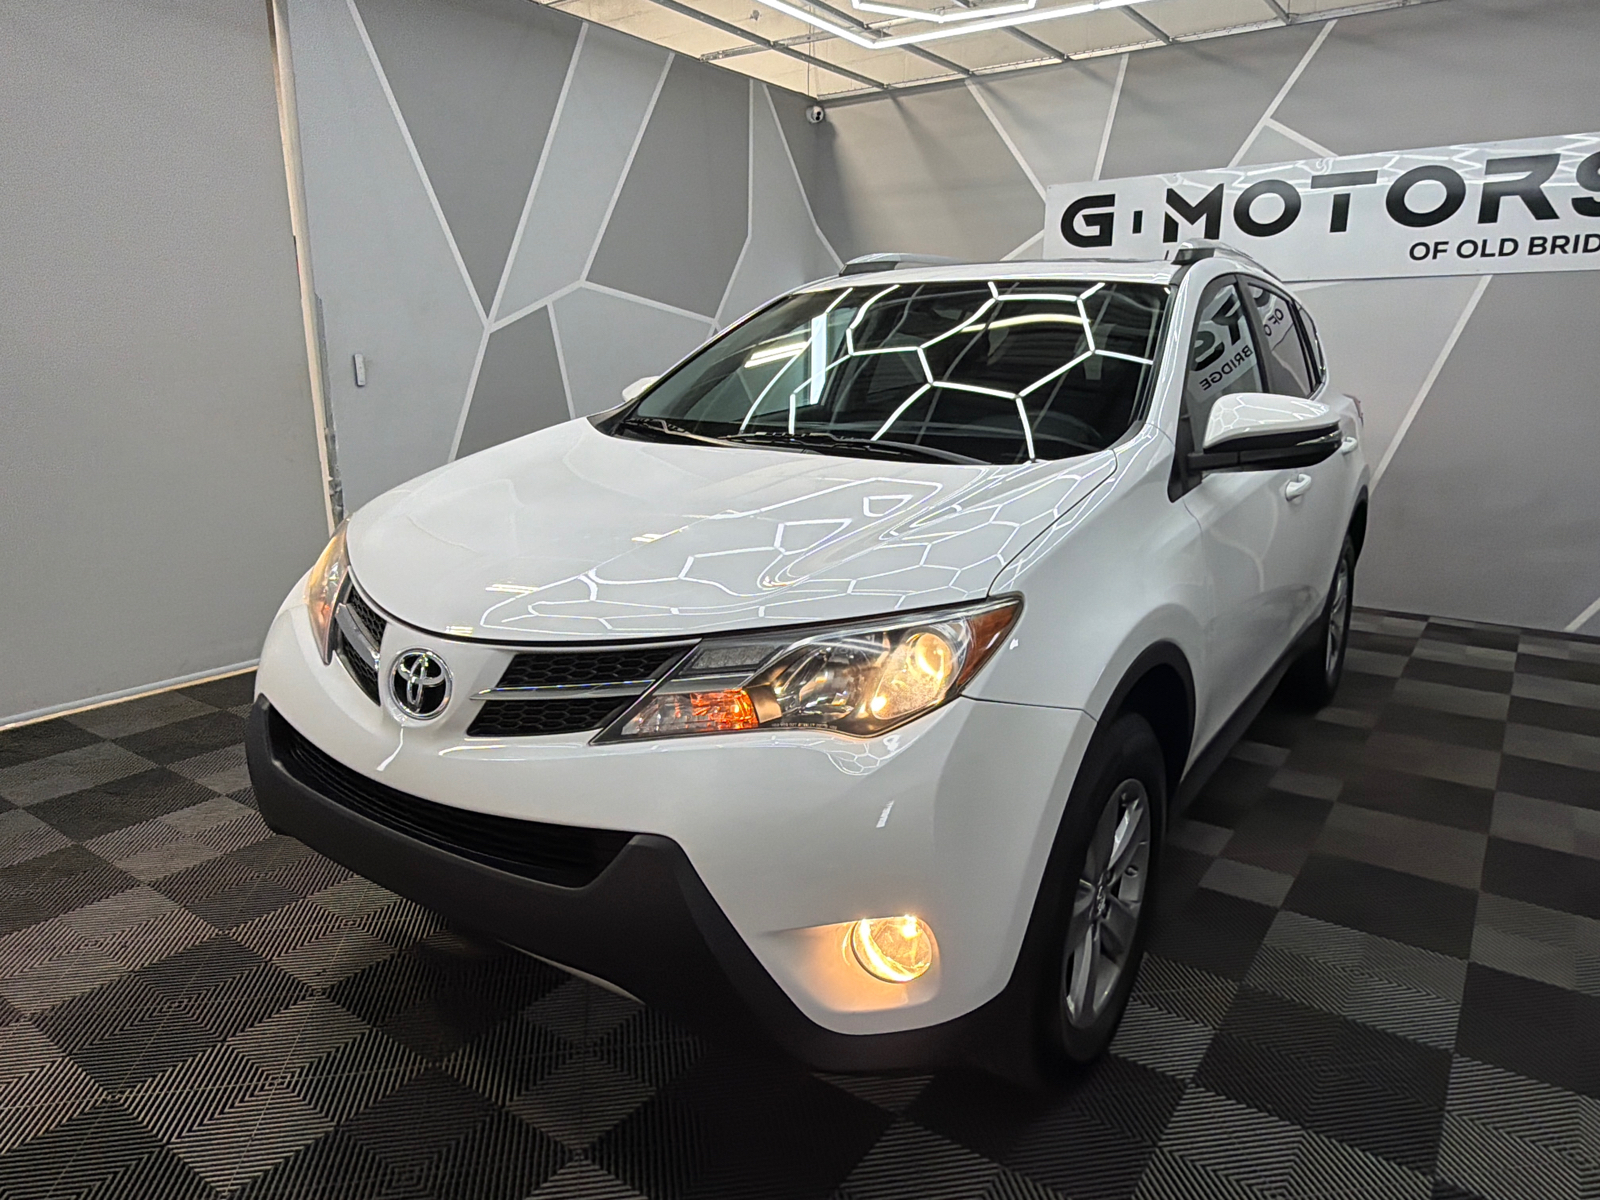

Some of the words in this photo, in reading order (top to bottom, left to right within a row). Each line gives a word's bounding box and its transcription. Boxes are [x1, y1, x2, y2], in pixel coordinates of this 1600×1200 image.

[1409, 241, 1450, 261] OF
[1456, 238, 1519, 259] OLD
[1527, 233, 1600, 256] BRID
